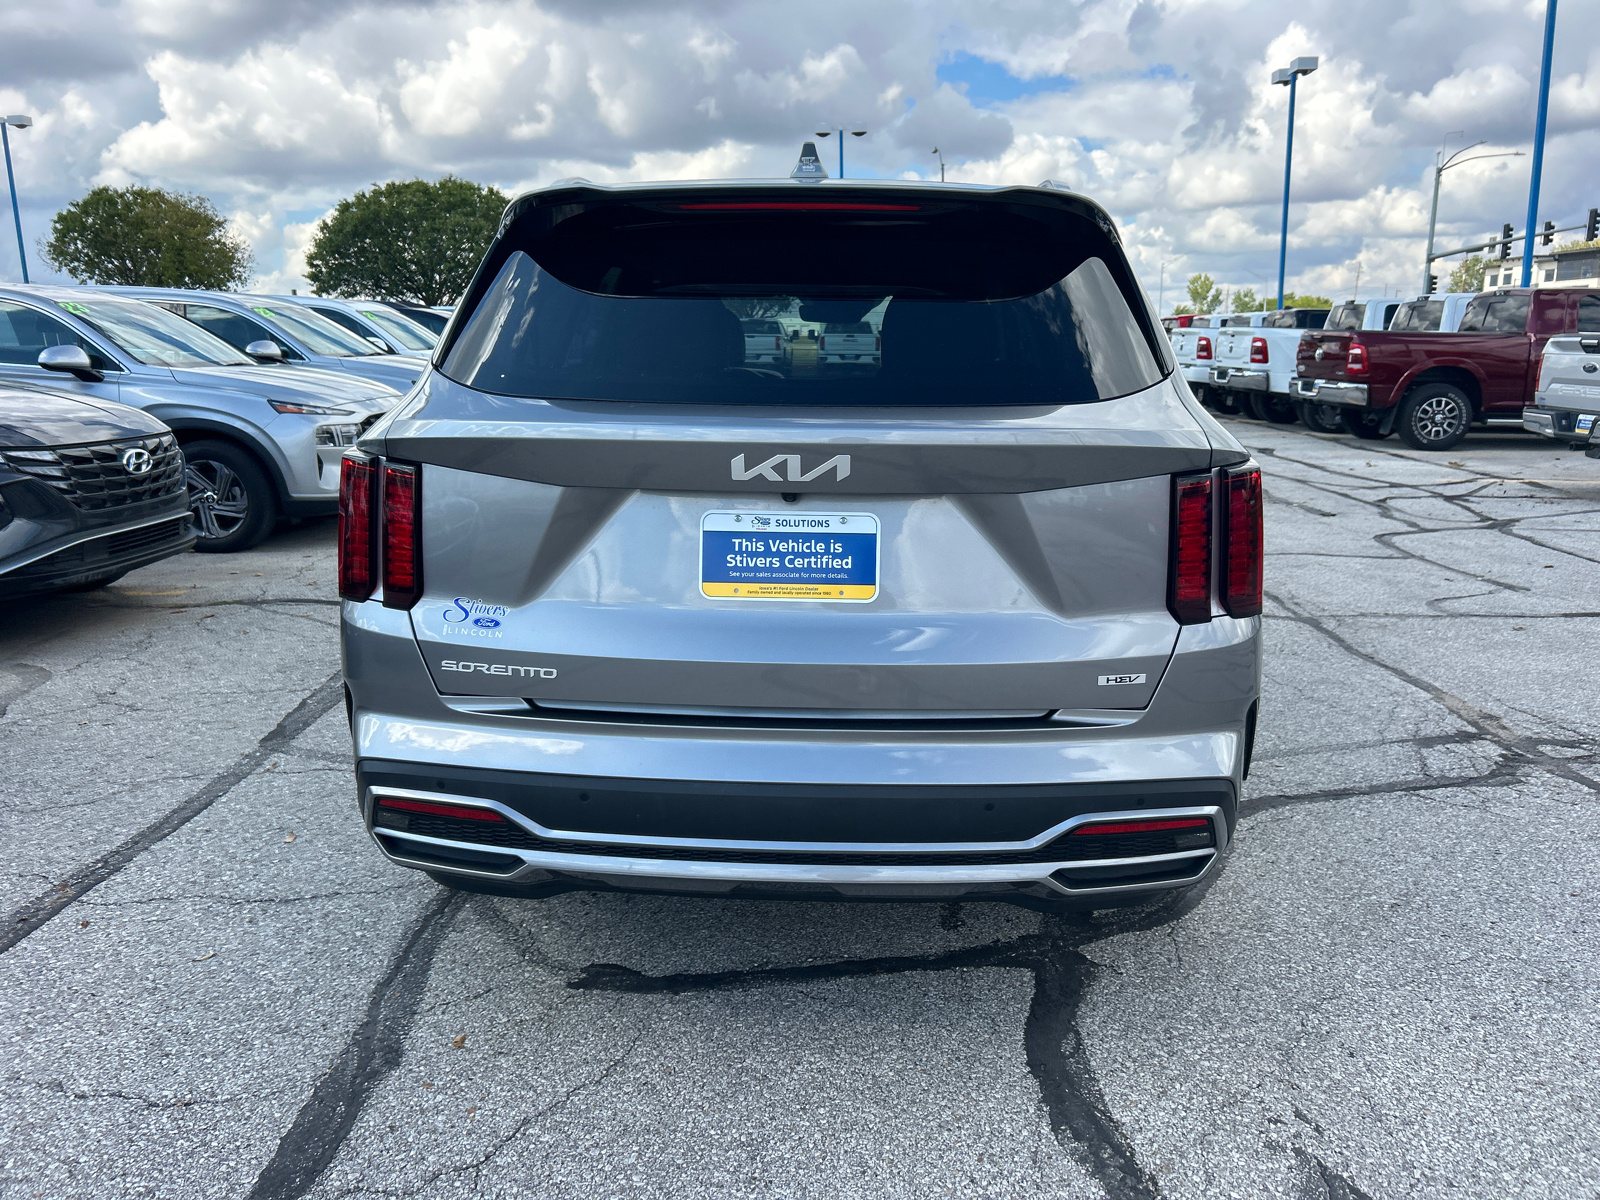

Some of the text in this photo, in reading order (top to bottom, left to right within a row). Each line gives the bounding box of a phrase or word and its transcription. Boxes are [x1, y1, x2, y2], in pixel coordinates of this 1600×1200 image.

[731, 453, 851, 482] KIA
[775, 519, 830, 528] SOLUTIONS
[732, 538, 843, 553] This Vehicle is
[726, 554, 852, 569] Stivers Certified
[442, 597, 510, 623] Stivers
[447, 626, 503, 639] LINCOLN
[441, 659, 558, 679] SORENTO
[1106, 675, 1141, 684] HEV
